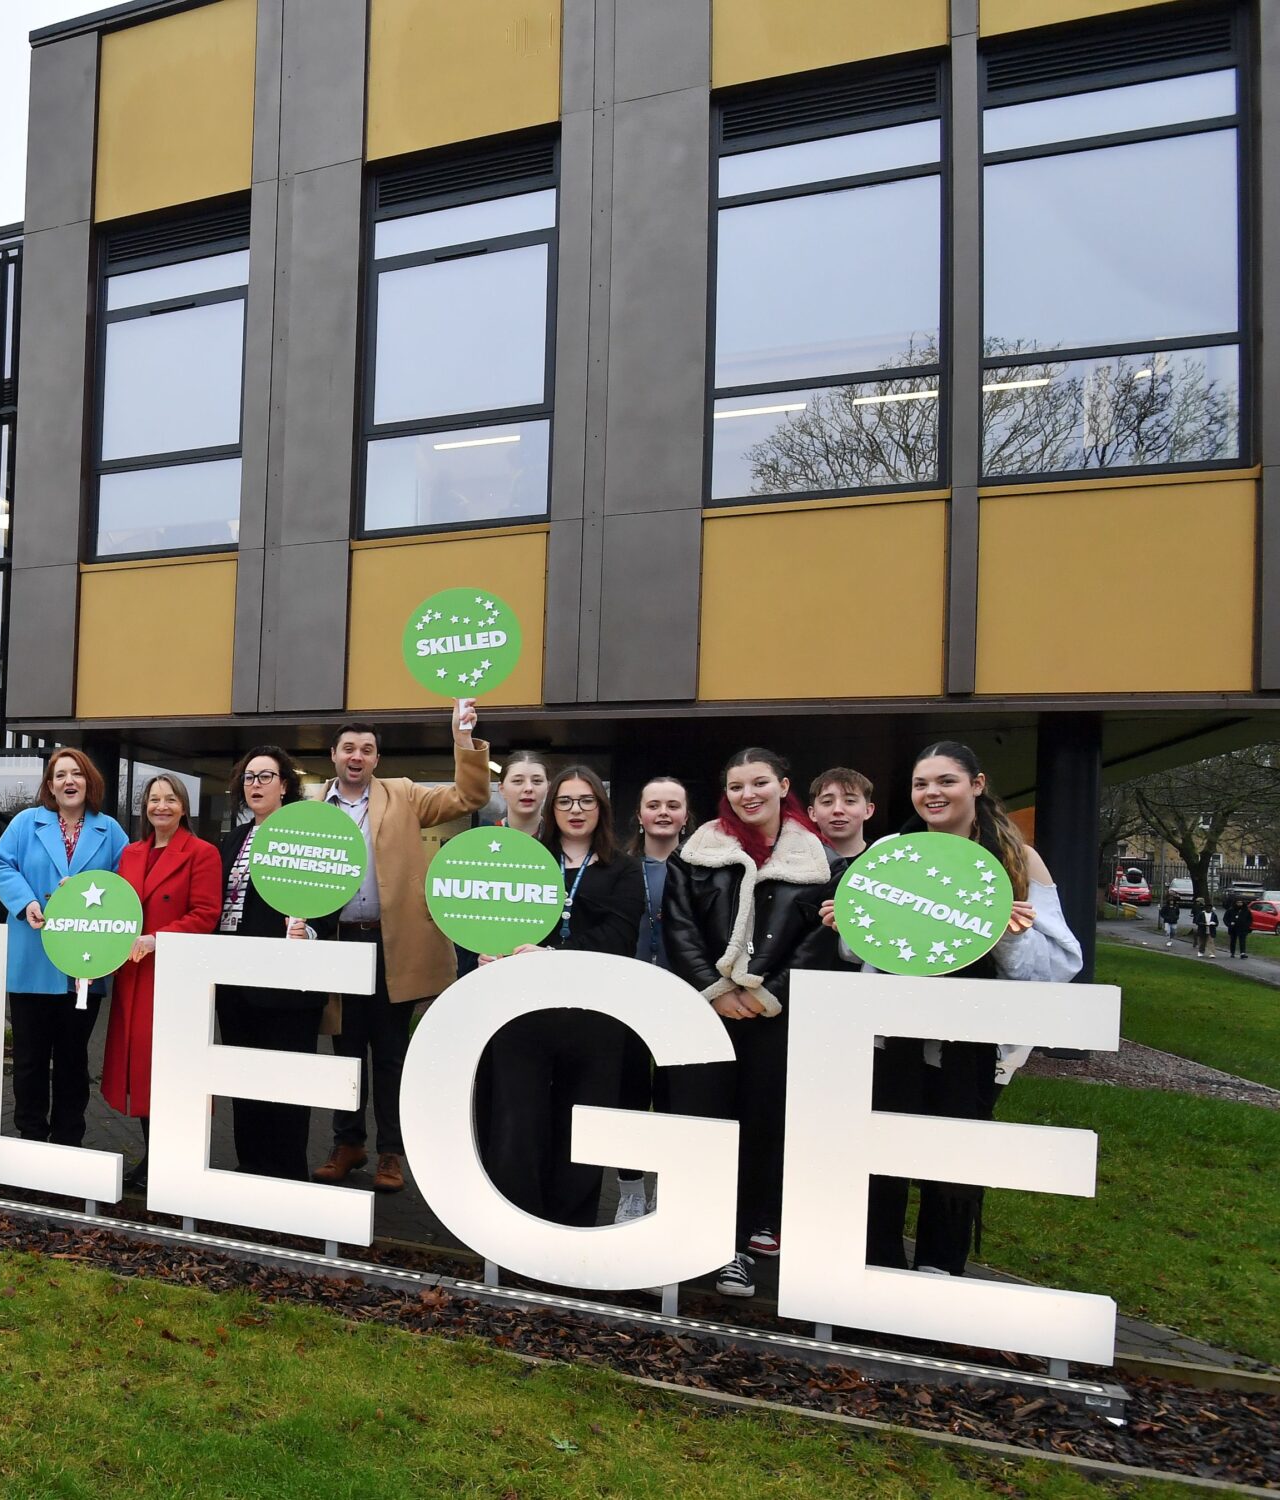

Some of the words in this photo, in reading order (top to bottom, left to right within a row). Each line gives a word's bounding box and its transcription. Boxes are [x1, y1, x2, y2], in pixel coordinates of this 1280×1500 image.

[415, 630, 507, 657] SKILLED
[266, 840, 350, 863] POWERFUL
[251, 852, 362, 879] PARTNERSHIPS
[431, 876, 559, 905] NURTURE
[846, 872, 995, 940] EXCEPTIONAL
[43, 917, 138, 935] ASPIRATION
